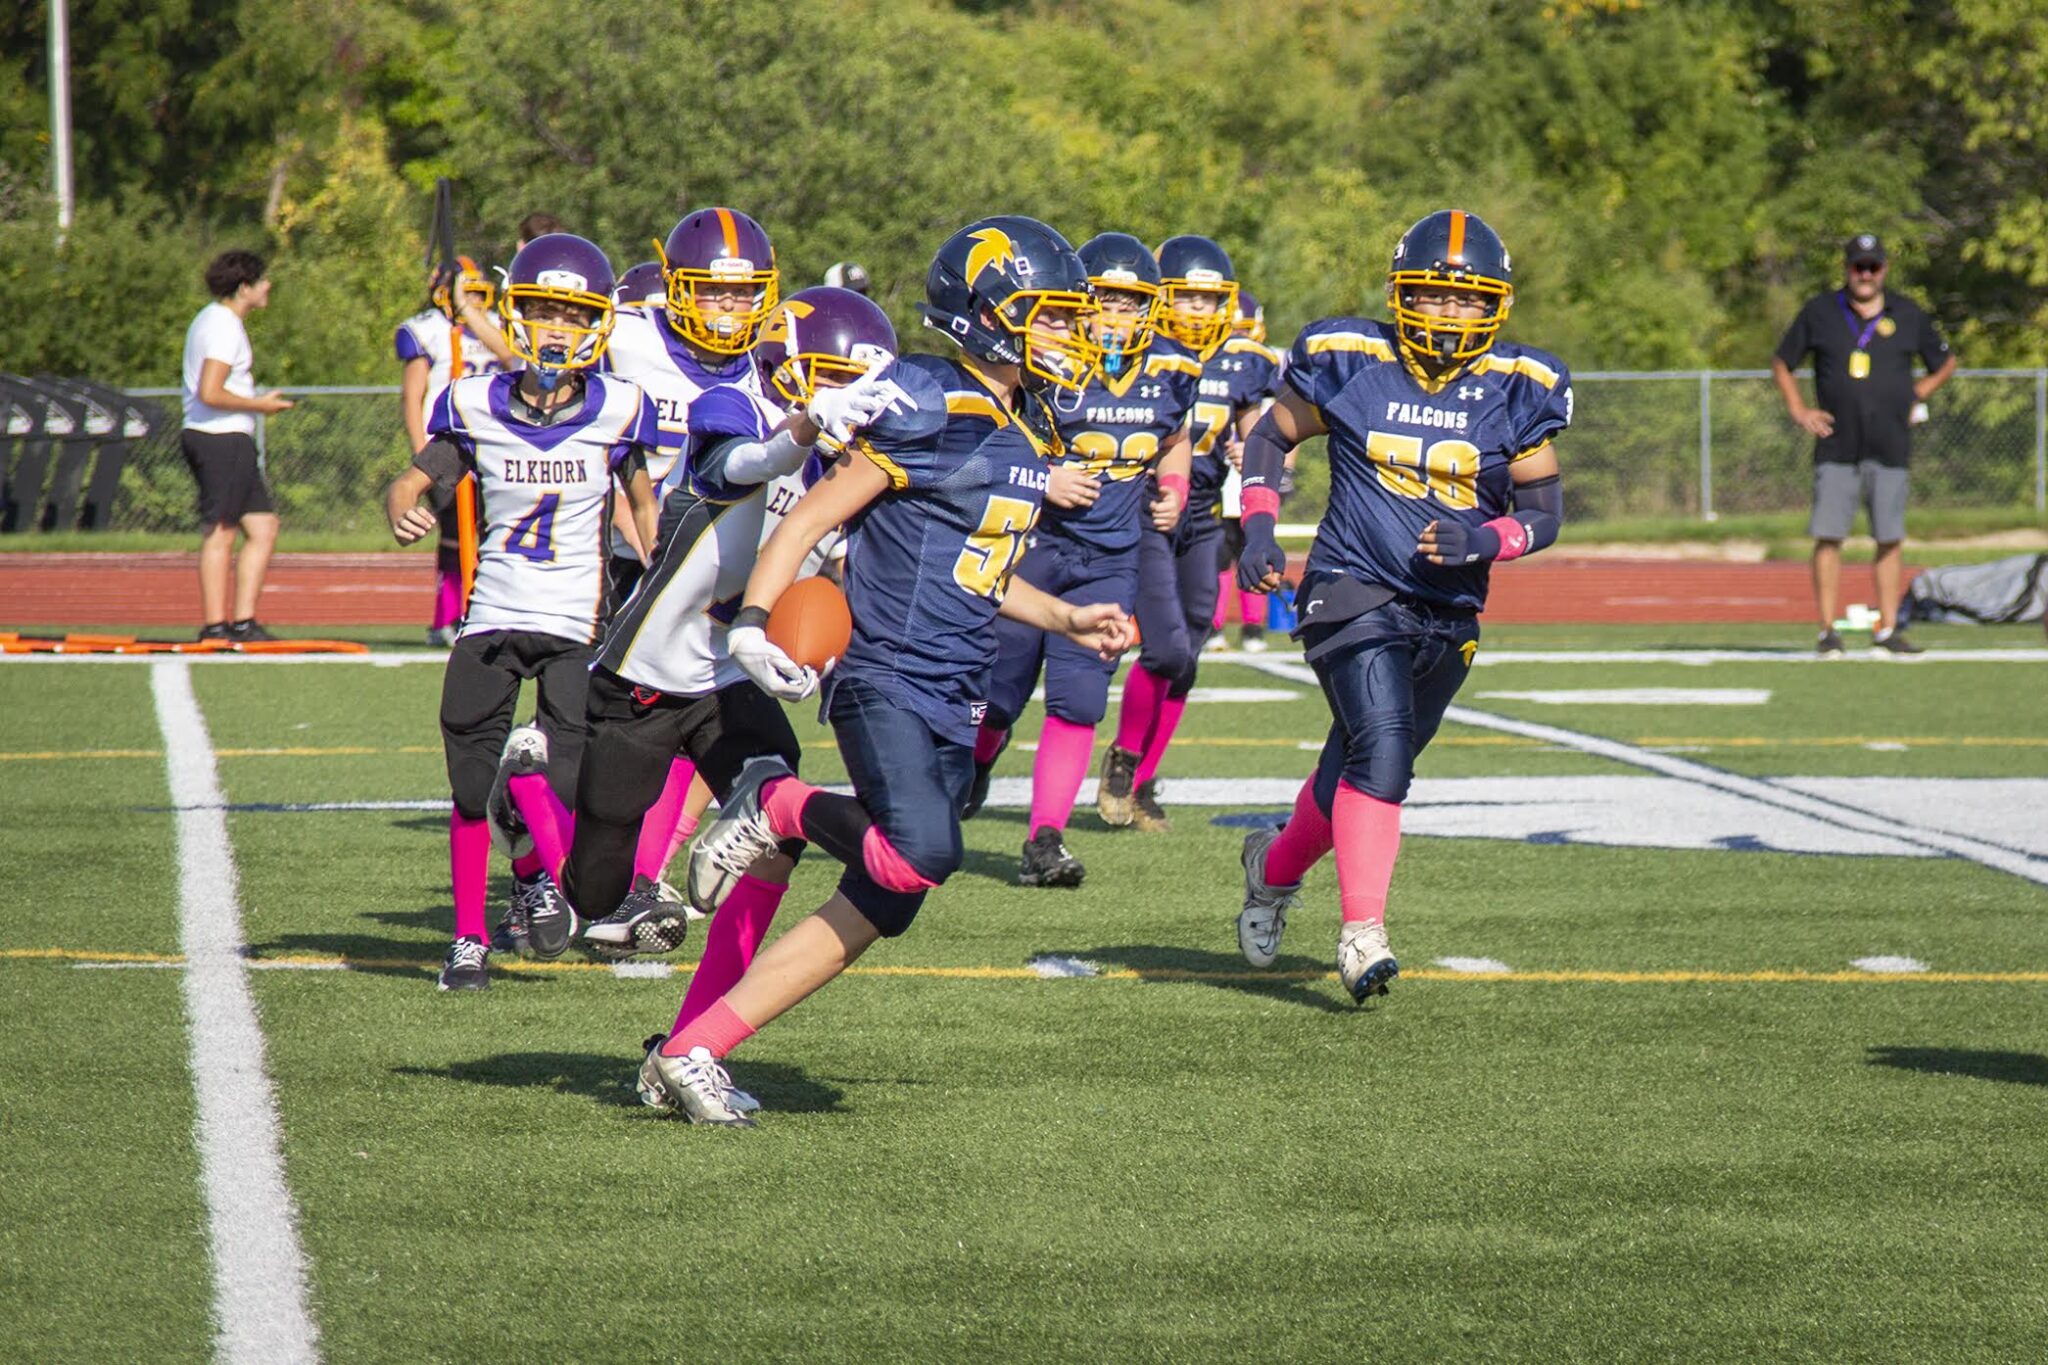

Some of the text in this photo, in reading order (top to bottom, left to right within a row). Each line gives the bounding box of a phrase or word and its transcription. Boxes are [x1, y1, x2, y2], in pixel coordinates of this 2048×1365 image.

[1086, 406, 1155, 424] FALCONS
[1184, 402, 1230, 456] 7
[1386, 401, 1469, 430] FALCONS
[503, 459, 587, 484] ELKHORN
[503, 490, 564, 564] 4
